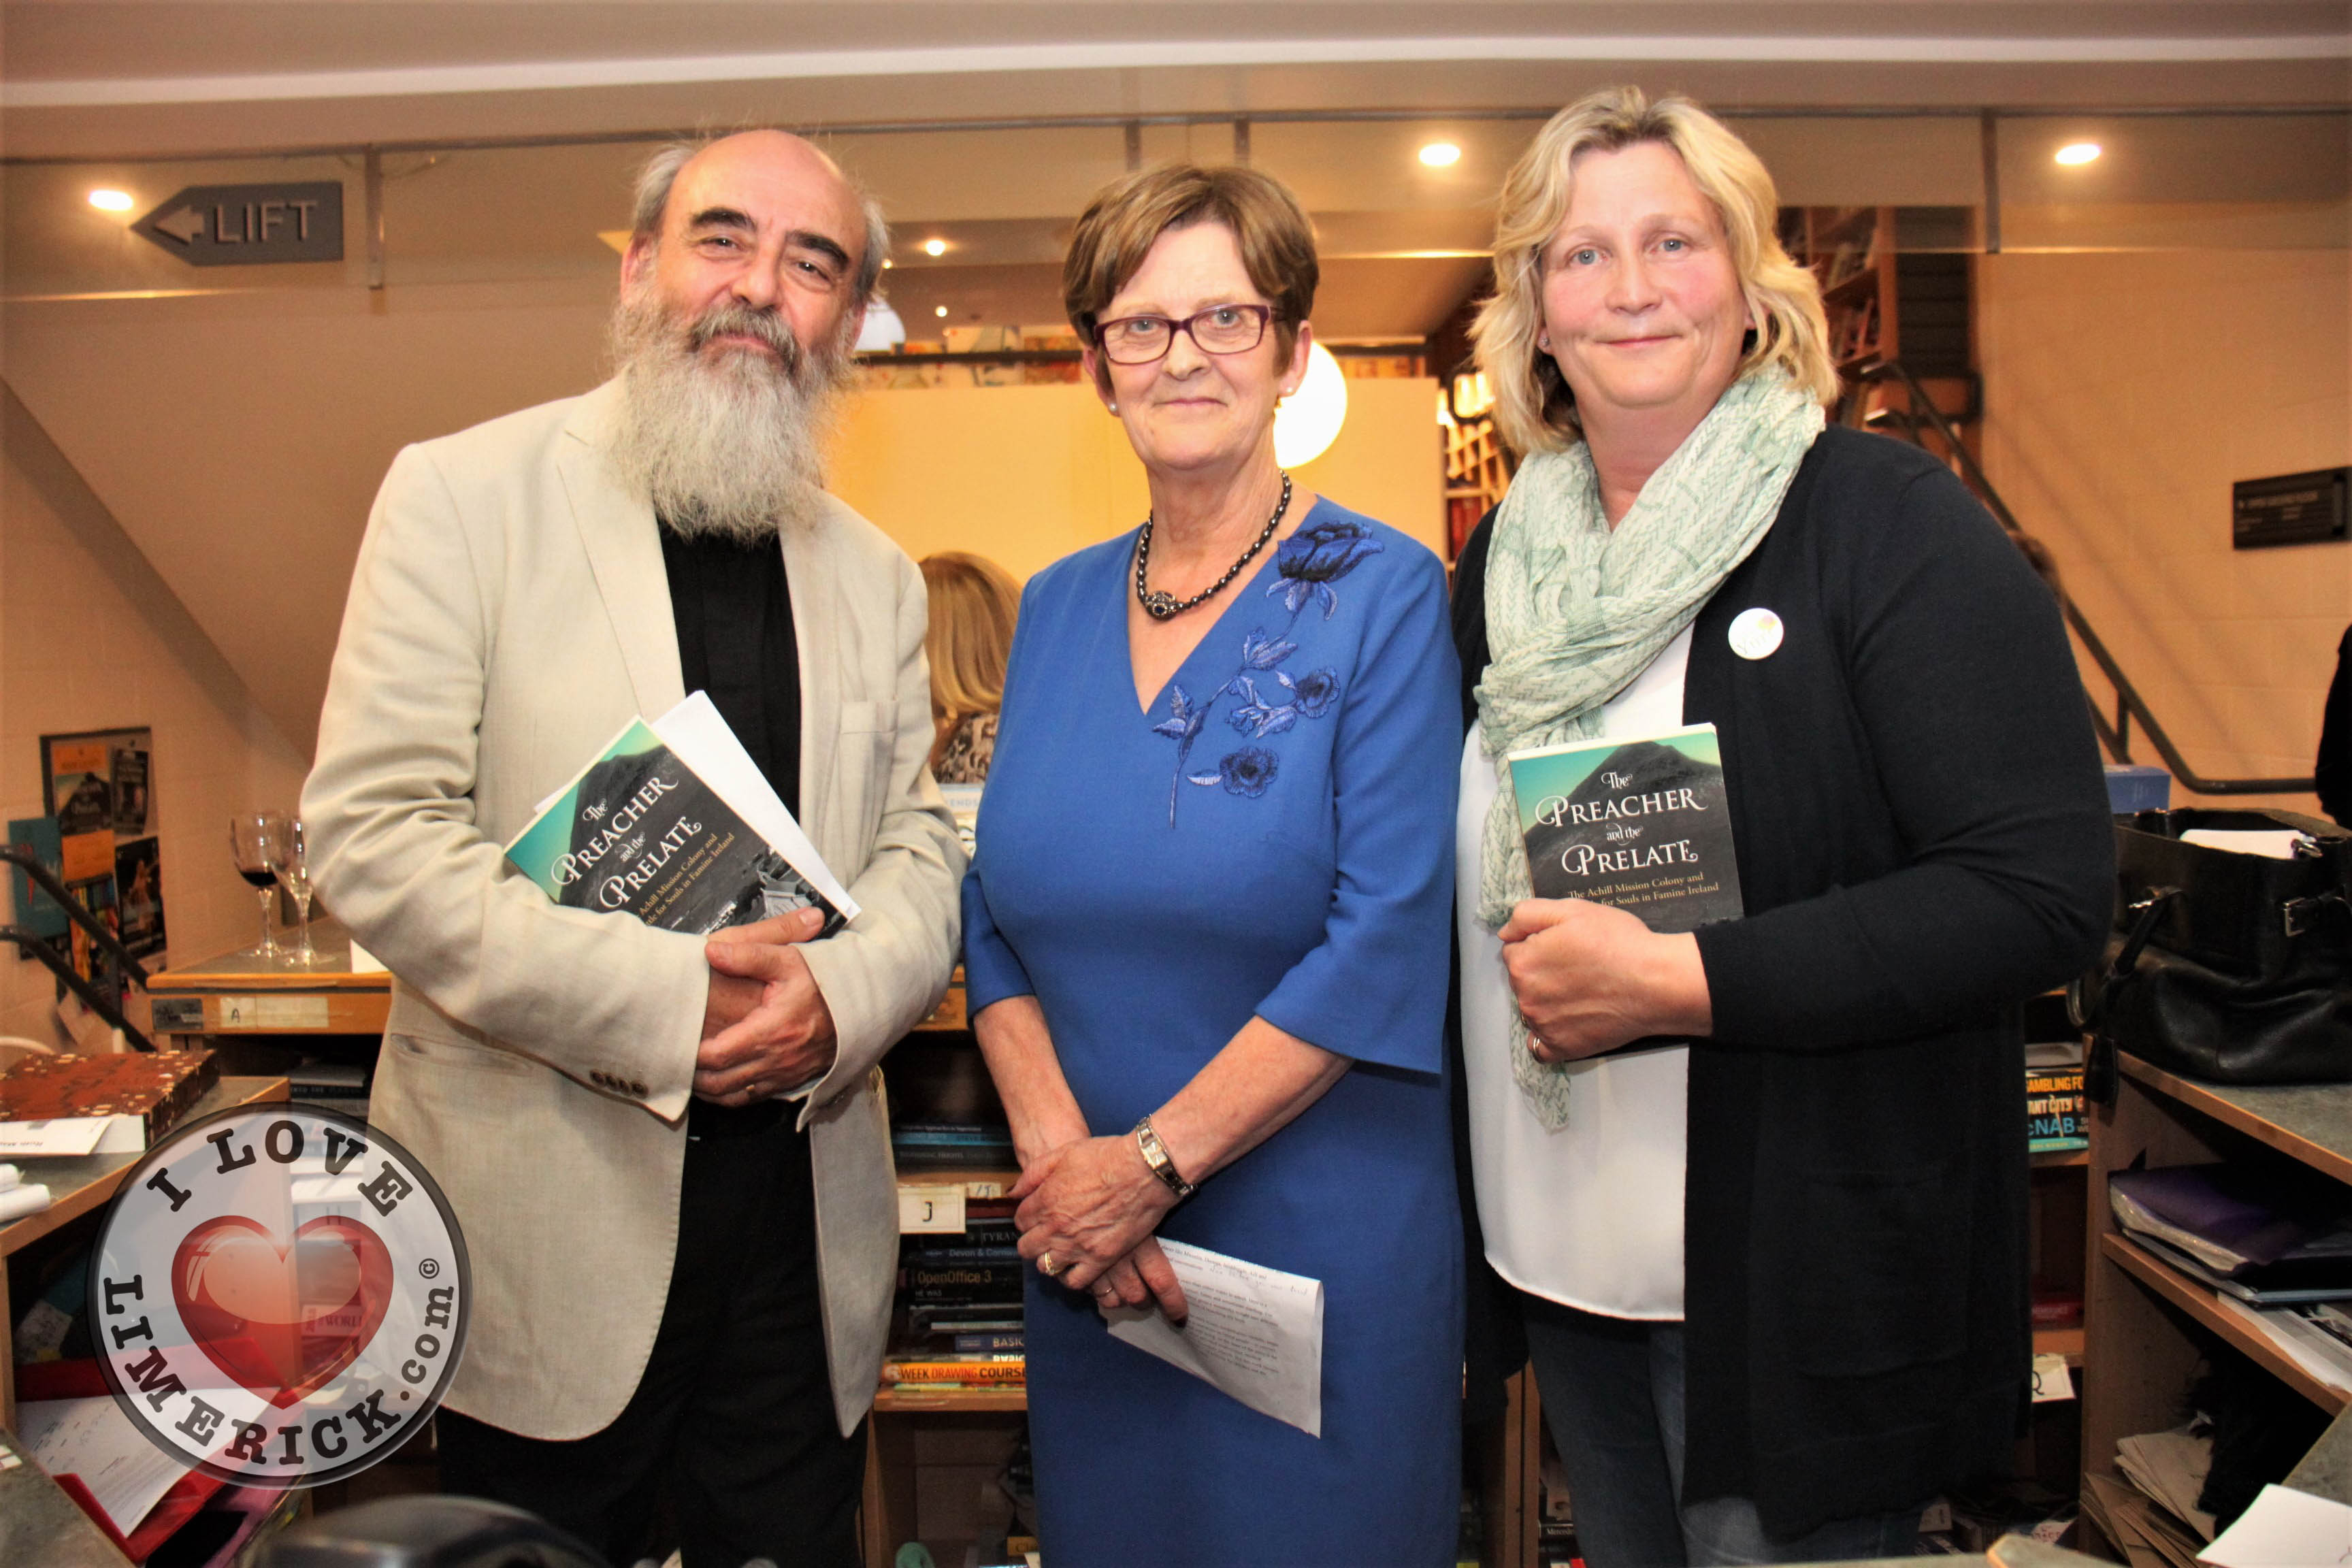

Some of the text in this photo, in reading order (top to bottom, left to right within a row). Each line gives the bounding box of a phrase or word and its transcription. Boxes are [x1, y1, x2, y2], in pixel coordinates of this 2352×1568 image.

[214, 200, 318, 243] LIFT
[1601, 771, 1633, 789] The
[583, 798, 608, 823] The
[1535, 787, 1709, 828] PREACHER
[550, 777, 679, 886] PREACHER
[600, 816, 702, 909] PRELATE
[655, 904, 668, 915] for
[665, 887, 685, 905] Souls
[683, 879, 692, 888] in
[689, 856, 713, 881] Famine
[711, 832, 735, 858] Ireland
[1561, 839, 1699, 877] PRELATE
[640, 833, 718, 916] Achill Mission Colony and
[1568, 872, 1705, 899] The Achill Mission Colony and
[1616, 894, 1639, 905] Souls
[1653, 889, 1686, 900] Famine
[1687, 882, 1720, 895] Ireland
[922, 1200, 932, 1222] J
[918, 1270, 992, 1287] OpenOffice 3
[931, 1367, 977, 1379] DRAWING
